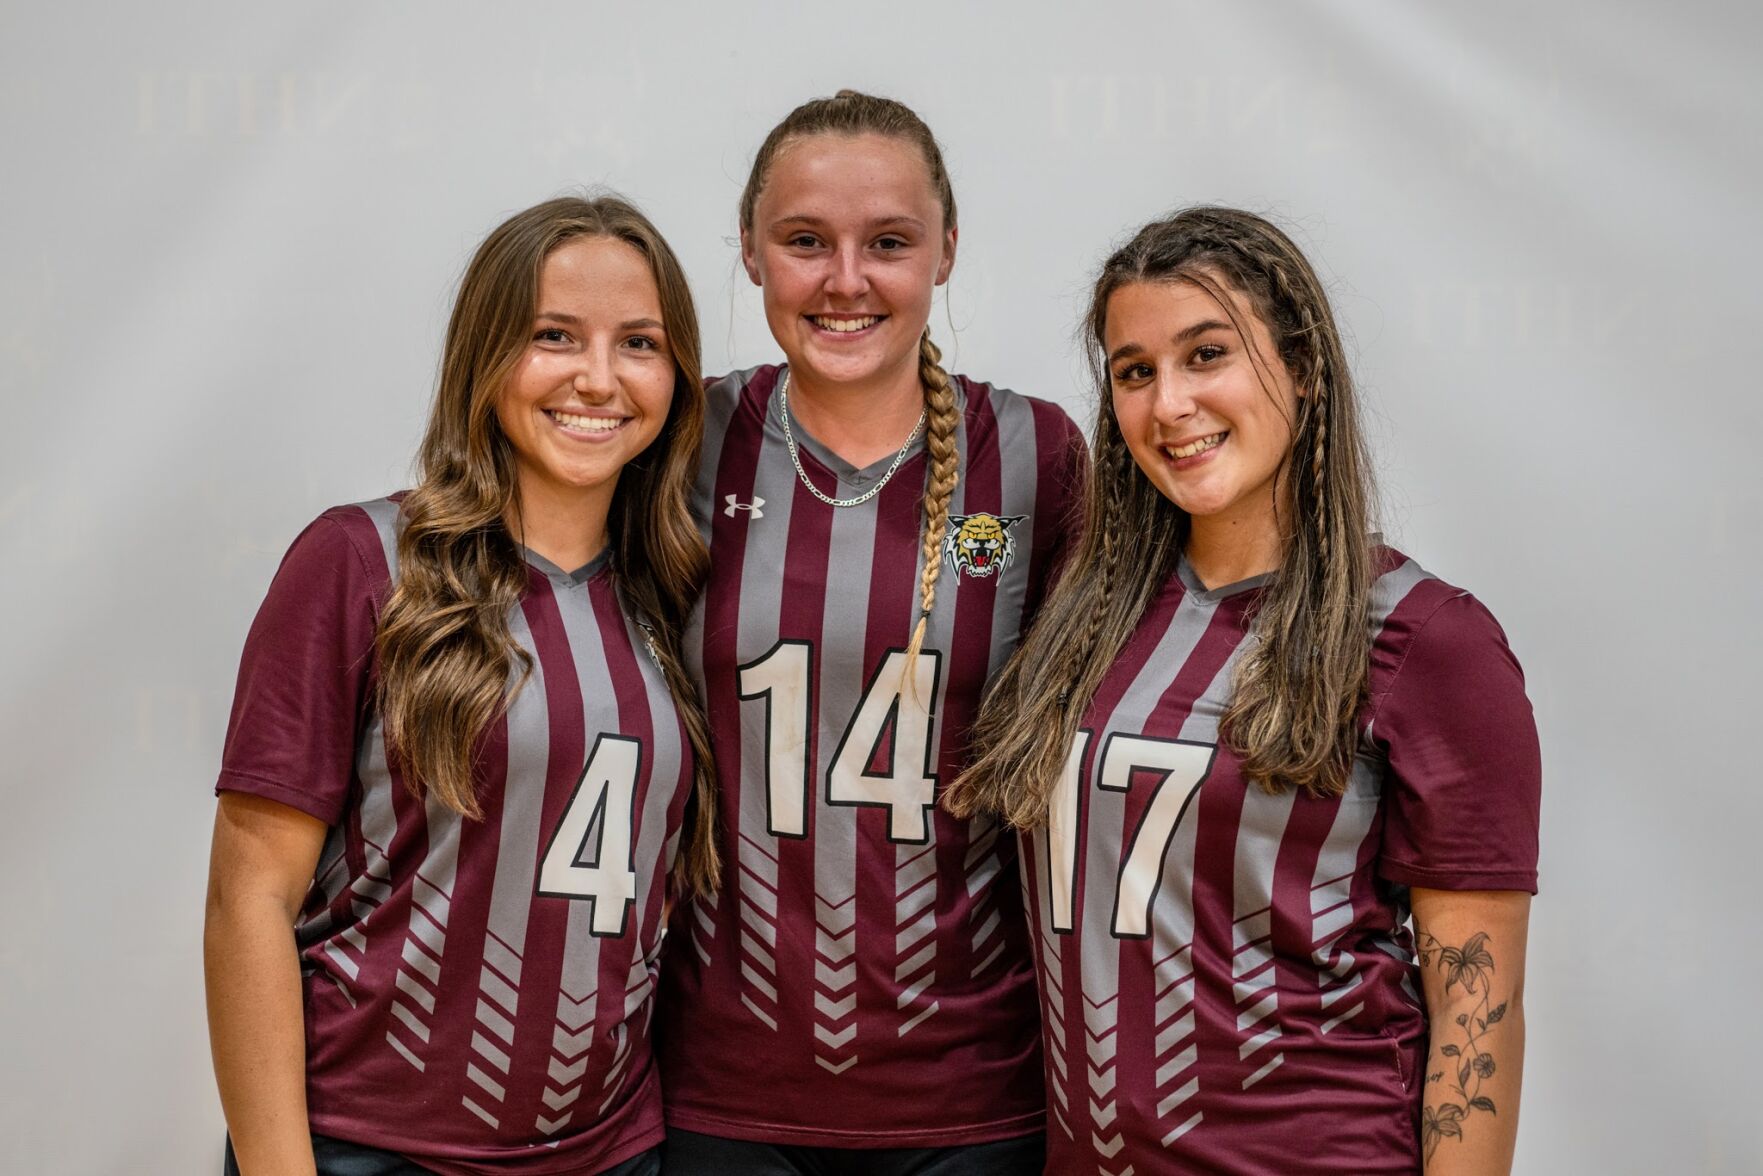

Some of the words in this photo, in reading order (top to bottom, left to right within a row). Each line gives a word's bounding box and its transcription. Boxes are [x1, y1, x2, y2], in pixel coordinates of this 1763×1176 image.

[536, 732, 642, 938] 4
[736, 638, 942, 845] 14
[1046, 728, 1218, 939] 17
